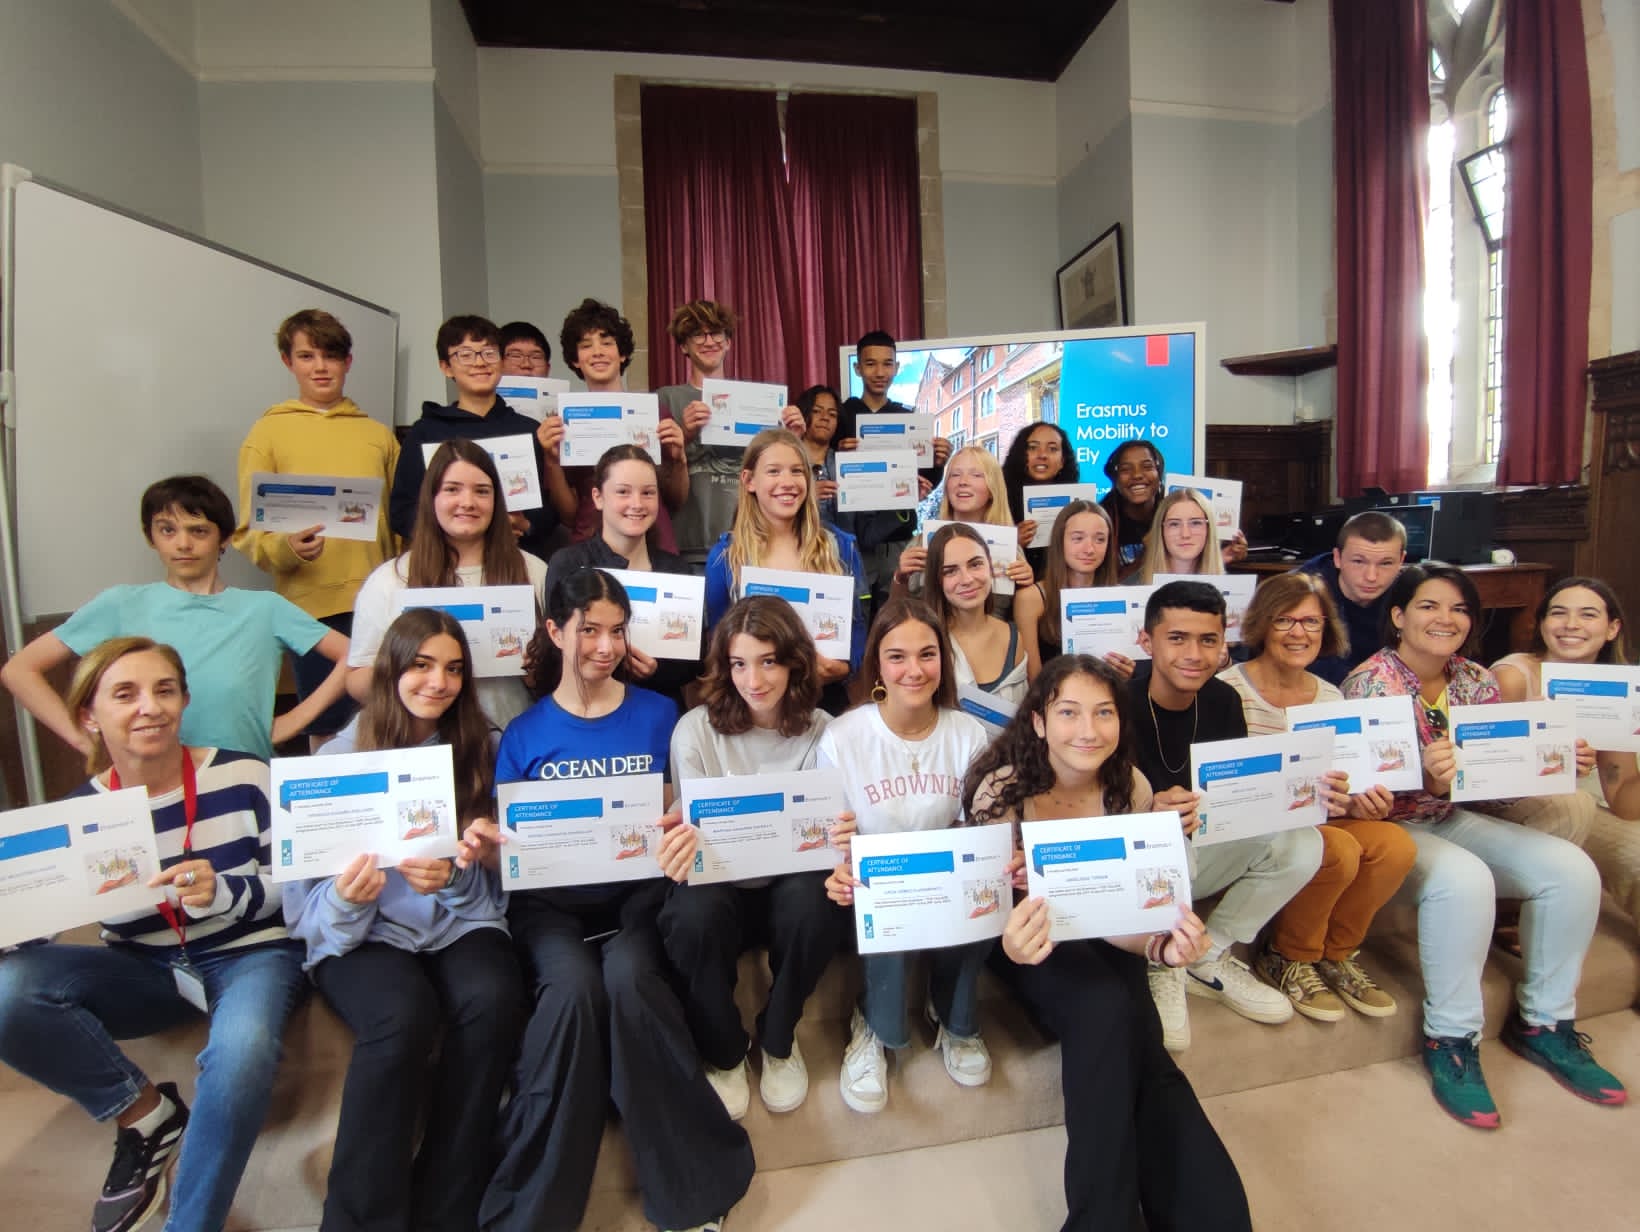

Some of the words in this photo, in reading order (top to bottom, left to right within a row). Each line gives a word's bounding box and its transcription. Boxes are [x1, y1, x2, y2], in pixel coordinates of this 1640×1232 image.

[1076, 403, 1147, 418] Erasmus
[1076, 423, 1146, 440] Mobility
[1150, 422, 1169, 438] to
[1076, 447, 1100, 465] Ely
[541, 758, 606, 779] OCEAN
[611, 754, 653, 775] DEEP
